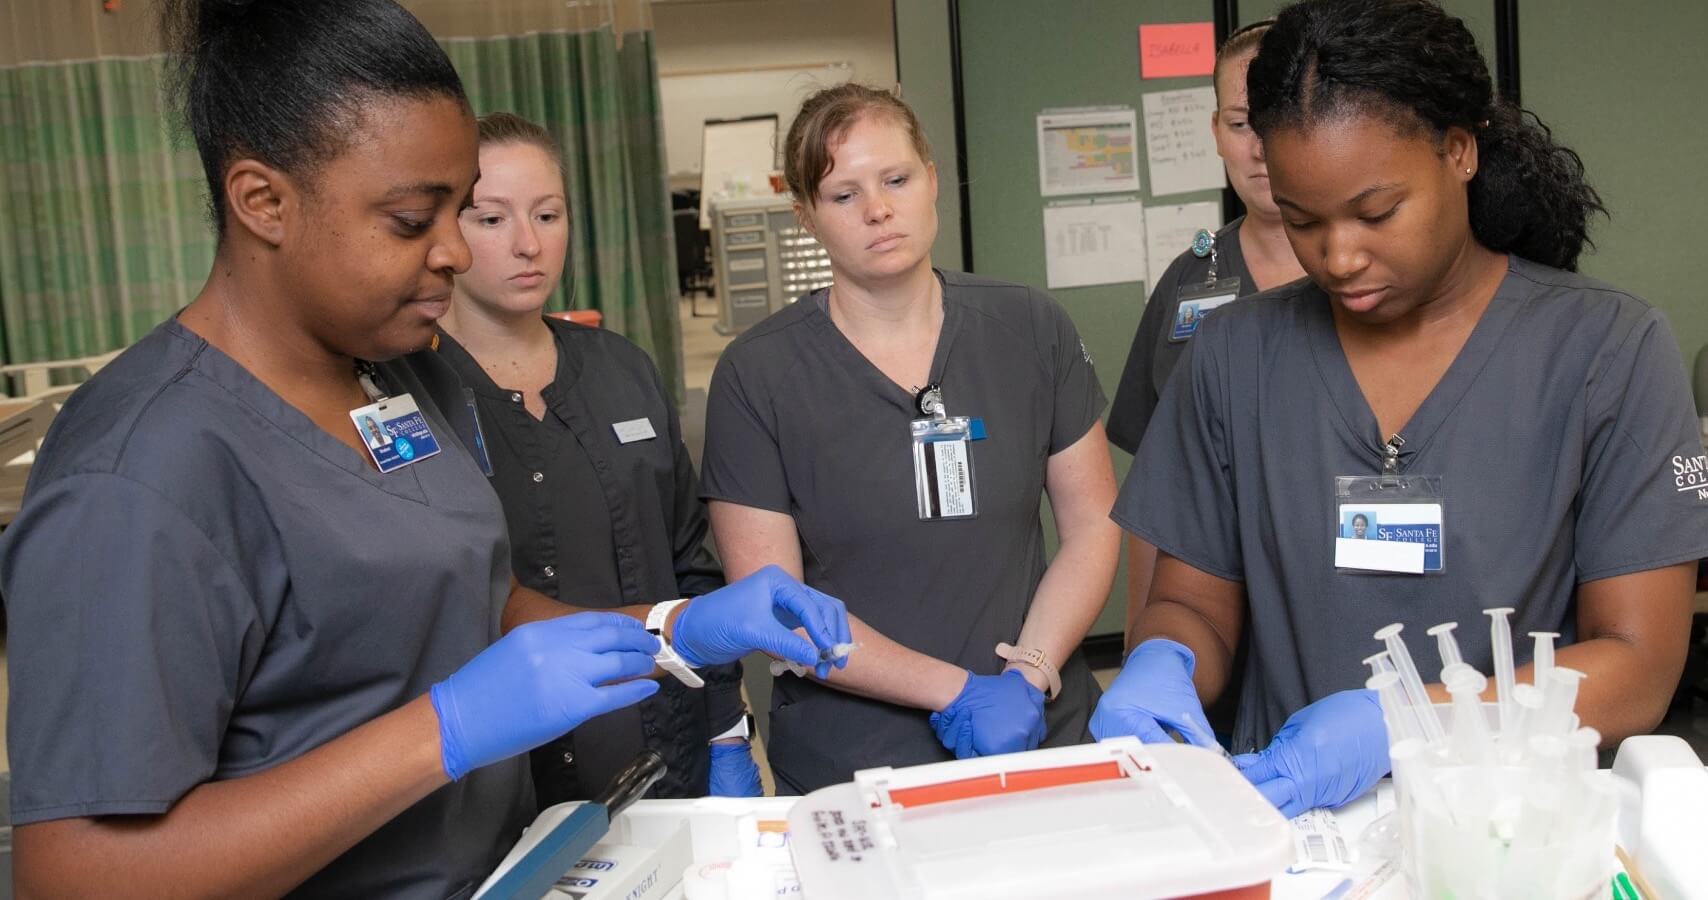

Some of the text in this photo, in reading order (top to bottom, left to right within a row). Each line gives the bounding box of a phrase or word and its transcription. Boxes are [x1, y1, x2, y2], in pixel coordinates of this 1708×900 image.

[1672, 454, 1708, 475] SANT
[1396, 528, 1437, 538] SANTA FE
